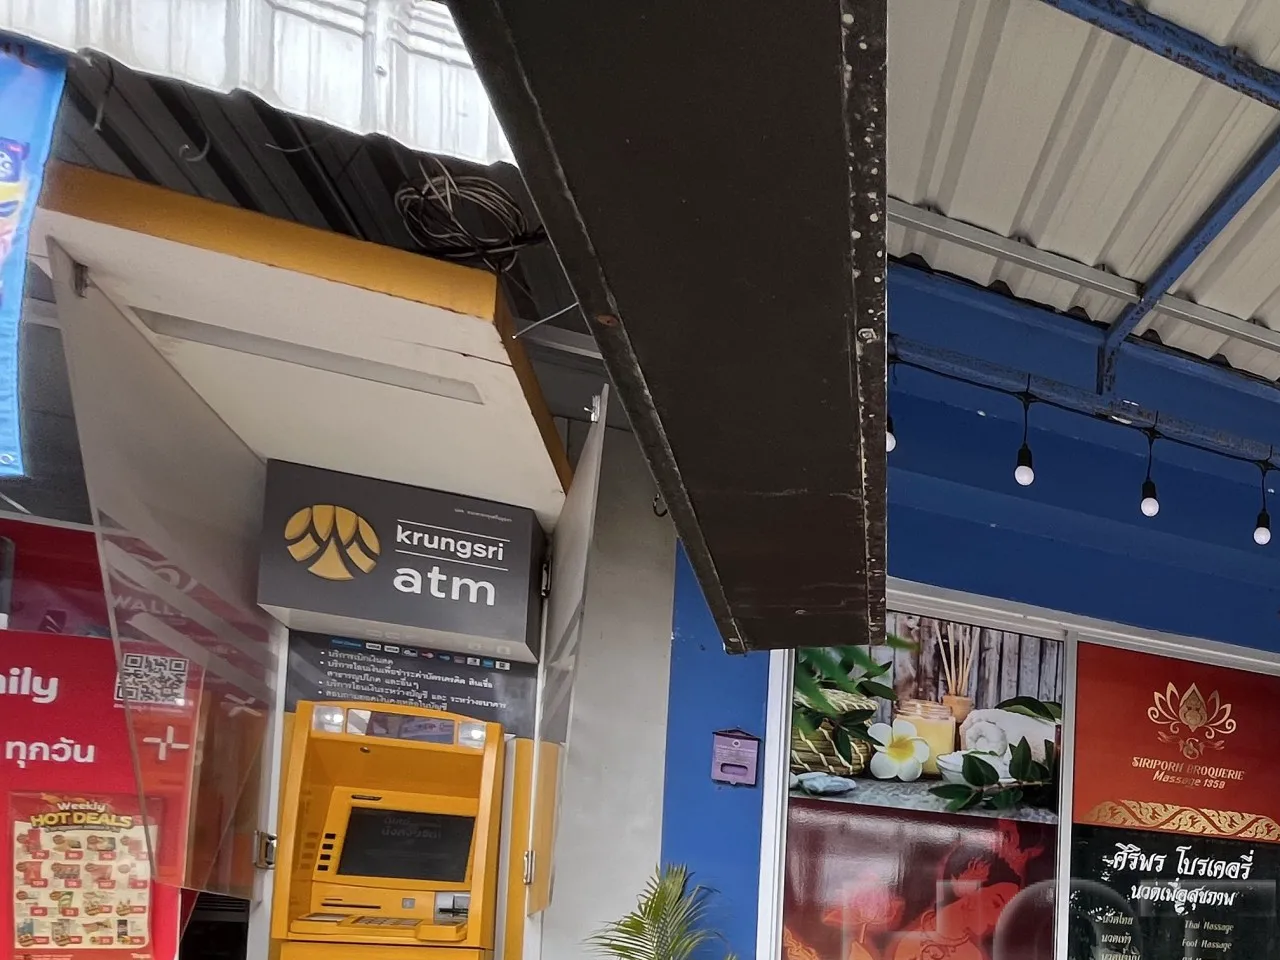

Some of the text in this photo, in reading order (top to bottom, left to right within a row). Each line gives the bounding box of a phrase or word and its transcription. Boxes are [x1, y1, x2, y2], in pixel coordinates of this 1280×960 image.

[395, 524, 504, 561] krungsri
[393, 566, 495, 606] atm
[0, 666, 59, 704] ily
[5, 736, 96, 768] ทุกวัน
[1132, 756, 1184, 774] SIRIPORN
[1152, 770, 1201, 789] Massage
[57, 801, 106, 812] Weekly
[31, 812, 132, 827] HOT DEALS
[1185, 920, 1234, 934] Thai Massage
[1182, 938, 1232, 952] Foot Massage
